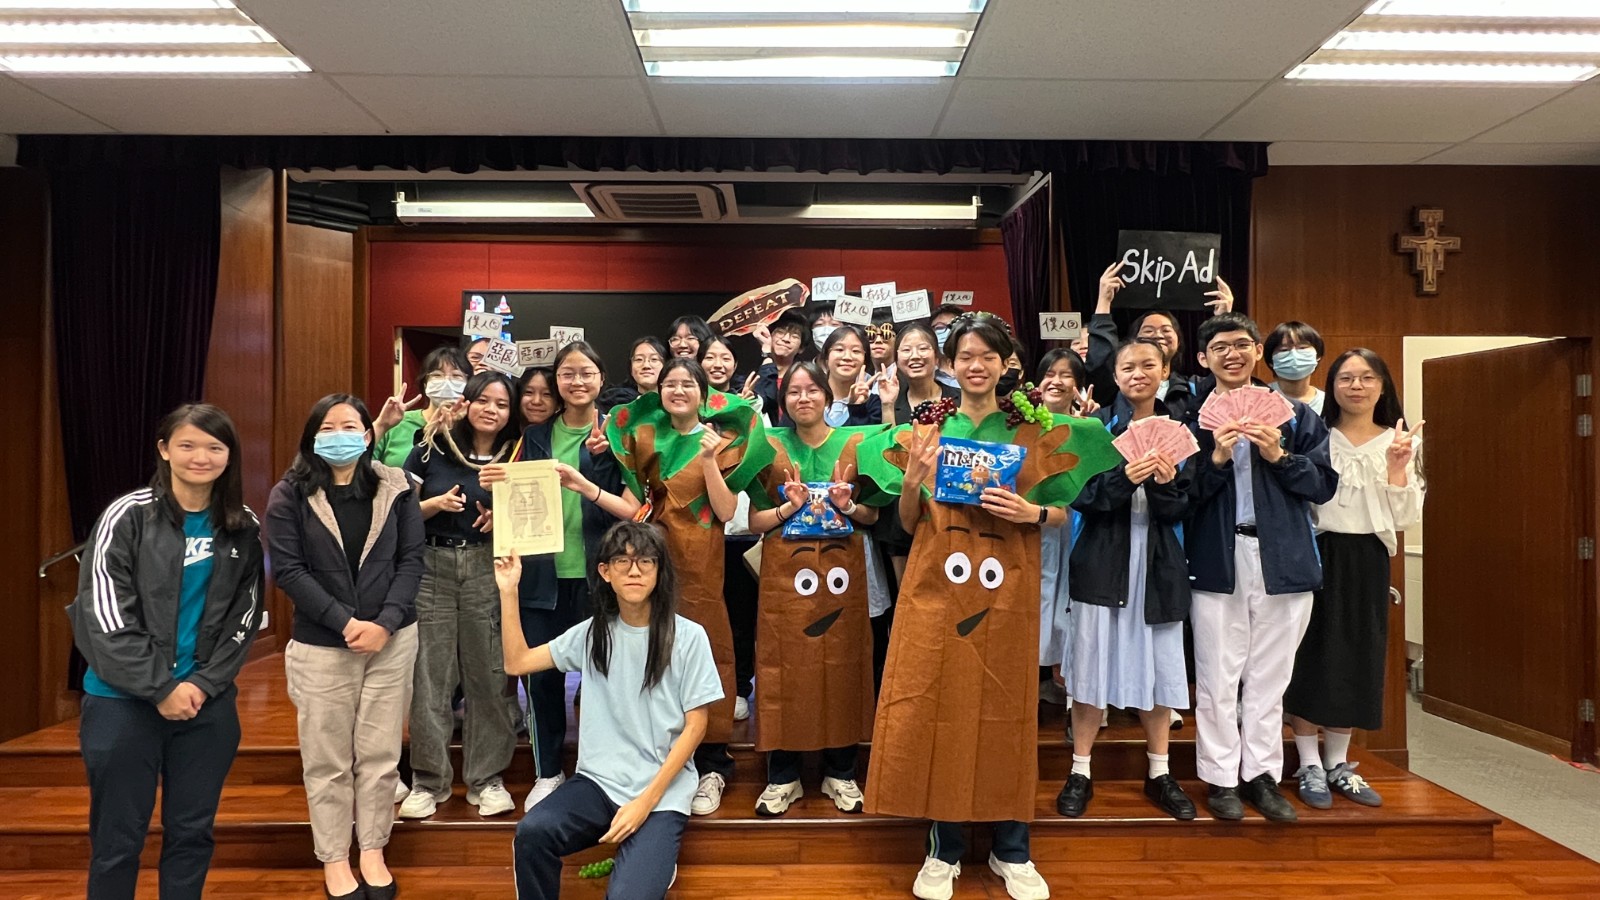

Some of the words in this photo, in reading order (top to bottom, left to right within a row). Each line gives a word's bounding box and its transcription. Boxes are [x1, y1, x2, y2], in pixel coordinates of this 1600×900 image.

[1121, 248, 1176, 299] Skip
[1178, 248, 1215, 284] Ad
[718, 291, 790, 331] DEFEAT
